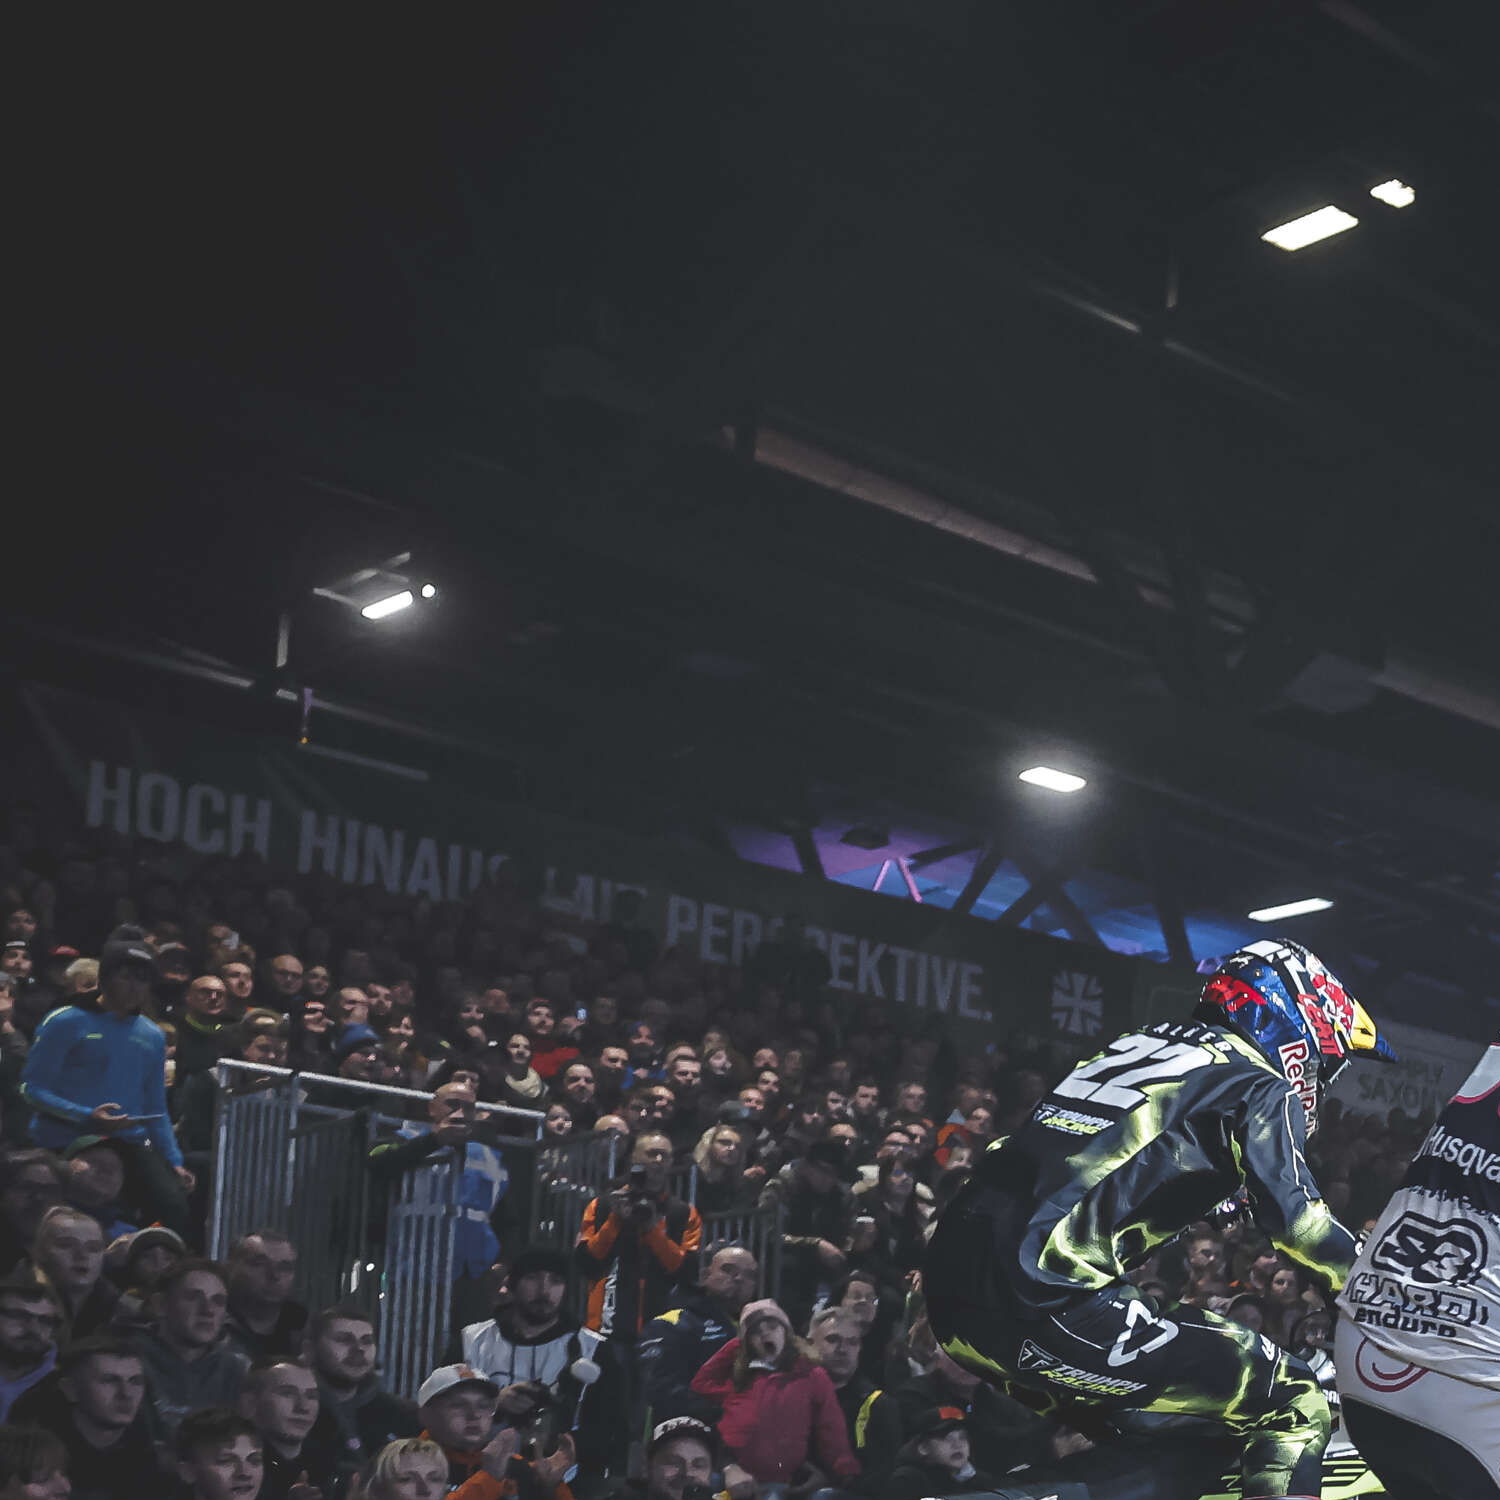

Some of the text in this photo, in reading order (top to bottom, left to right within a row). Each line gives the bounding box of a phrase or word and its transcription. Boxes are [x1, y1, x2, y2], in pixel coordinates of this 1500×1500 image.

[84, 759, 272, 864] HOCH
[298, 809, 511, 901] HINAU
[664, 896, 993, 1021] PEREKTIVE.
[1052, 1033, 1213, 1110] 22
[1039, 1369, 1128, 1396] RACING
[1055, 1363, 1148, 1392] TRIUMPH
